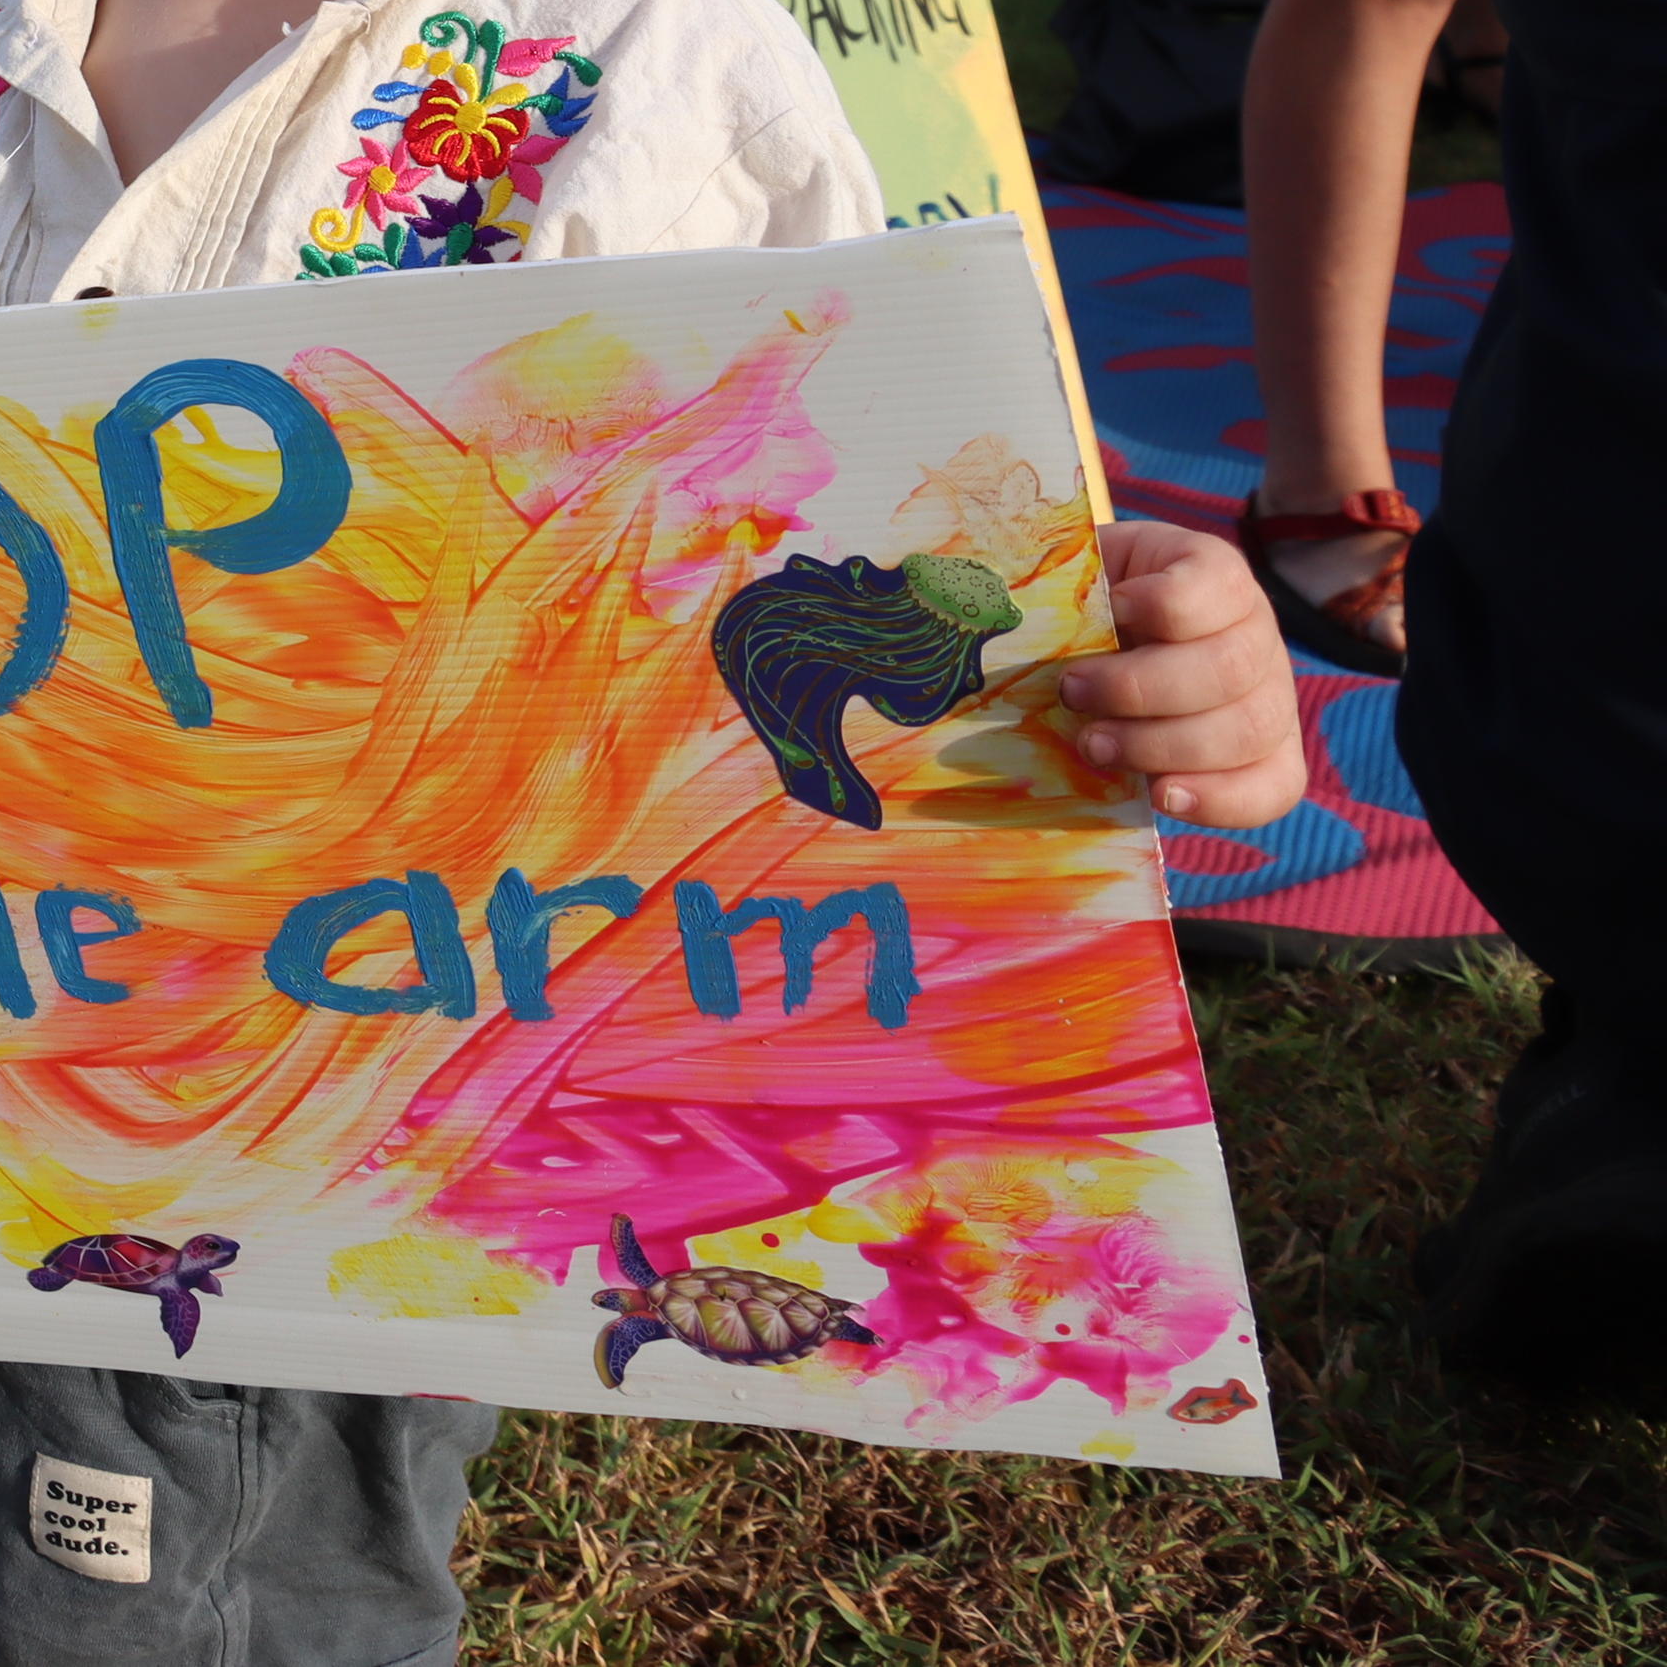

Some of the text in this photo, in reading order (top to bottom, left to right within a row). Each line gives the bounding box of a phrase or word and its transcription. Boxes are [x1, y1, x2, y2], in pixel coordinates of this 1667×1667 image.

[263, 867, 921, 1031] arm
[46, 1480, 138, 1514] Super
[44, 1510, 107, 1532] cool
[45, 1531, 129, 1556] dude.
